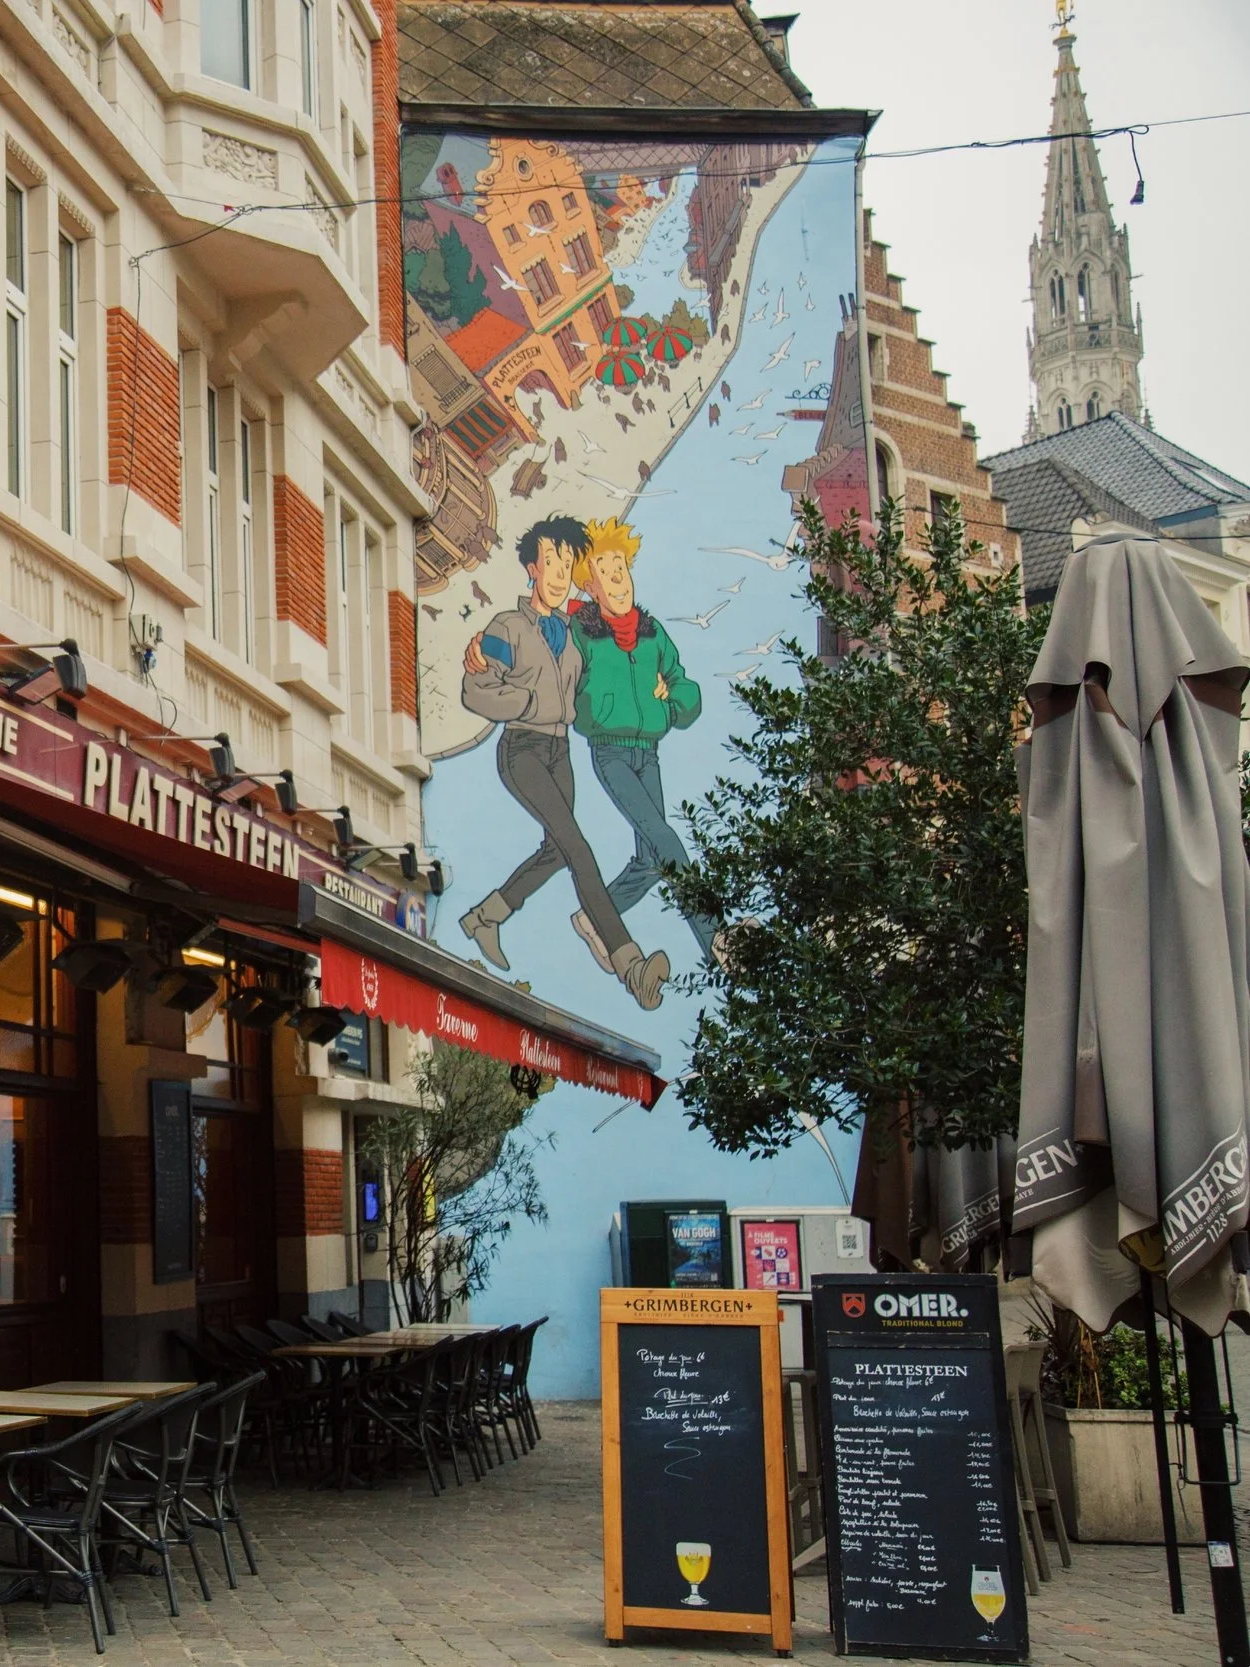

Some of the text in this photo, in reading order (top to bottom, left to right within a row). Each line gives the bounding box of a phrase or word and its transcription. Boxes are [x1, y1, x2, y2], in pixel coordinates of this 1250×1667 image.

[492, 345, 542, 389] PLATTESTEEN
[84, 741, 300, 880] PLATTESTEEN
[324, 871, 385, 918] RESTAURANT
[436, 992, 479, 1043] Taverne
[672, 1227, 716, 1239] VAN GOGH
[633, 1298, 744, 1313] GRIMBERGEN
[874, 1293, 969, 1318] OMER.
[882, 1319, 964, 1328] TRADITIONAL BLOND
[854, 1363, 969, 1378] PLATTESTEEN
